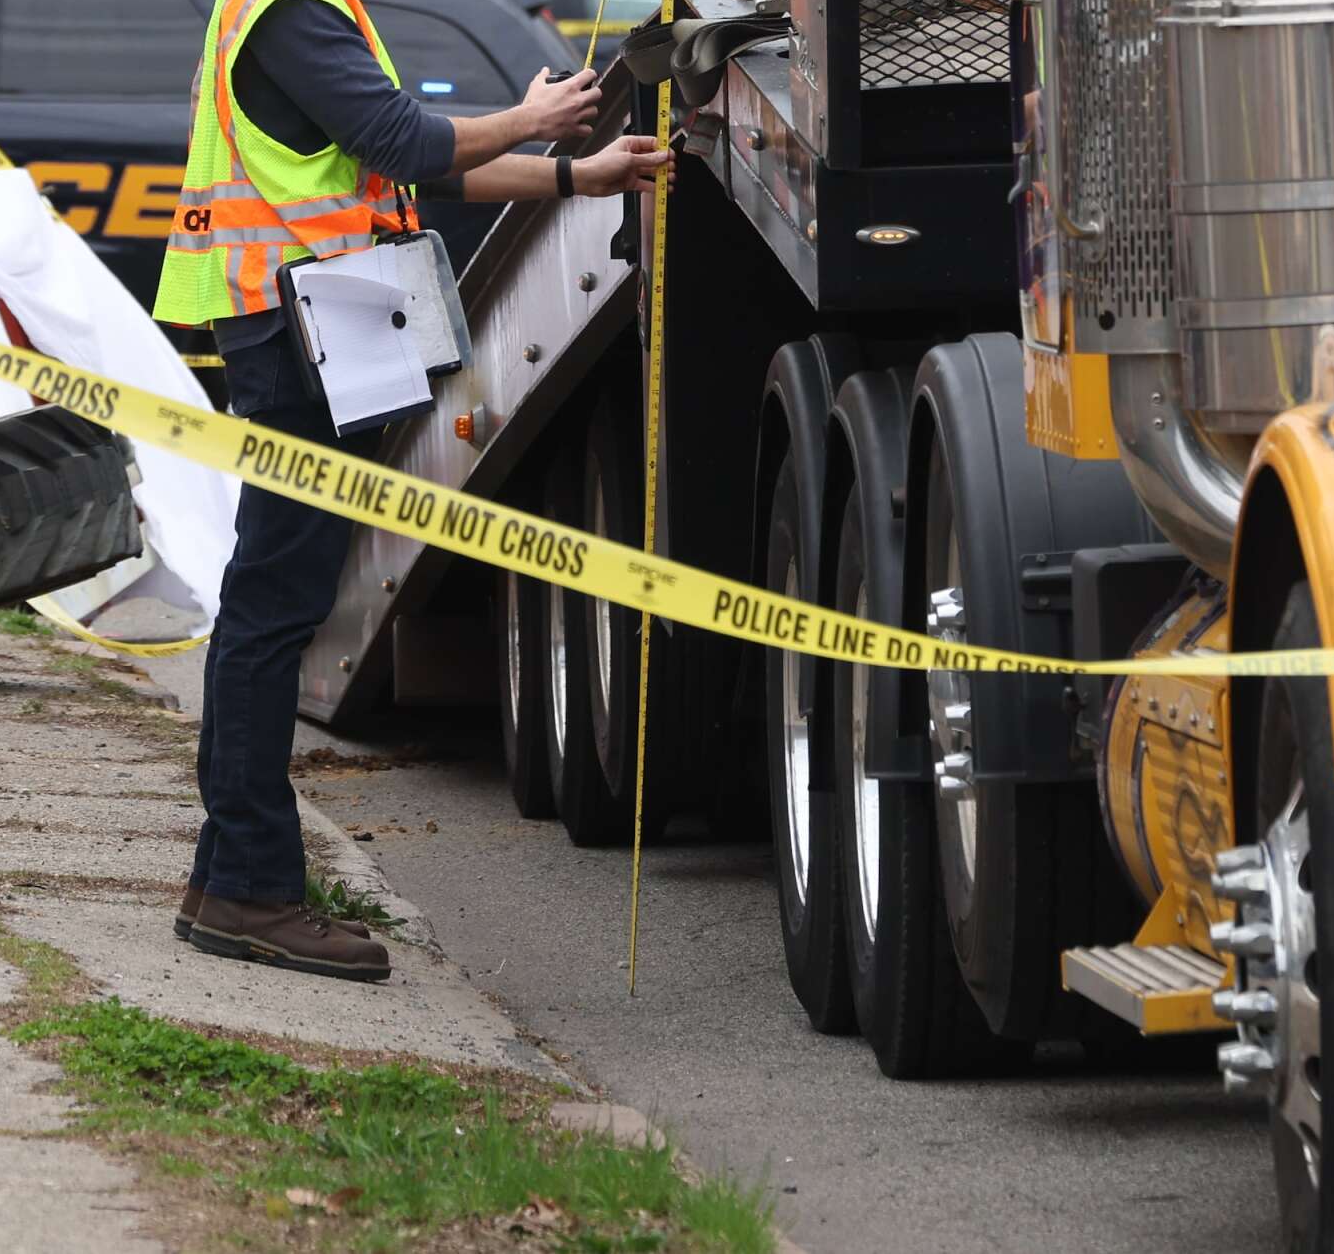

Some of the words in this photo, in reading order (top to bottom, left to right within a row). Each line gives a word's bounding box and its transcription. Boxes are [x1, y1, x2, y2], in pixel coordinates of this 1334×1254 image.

[32, 365, 120, 421] CROSS
[235, 434, 331, 495] POLICE
[334, 464, 395, 516] LINE
[396, 485, 436, 529] DO
[440, 499, 497, 548] NOT
[498, 518, 588, 578] CROSS
[712, 589, 810, 645] POLICE
[817, 619, 877, 660] LINE
[886, 636, 923, 666] DO
[933, 647, 987, 672] NOT
